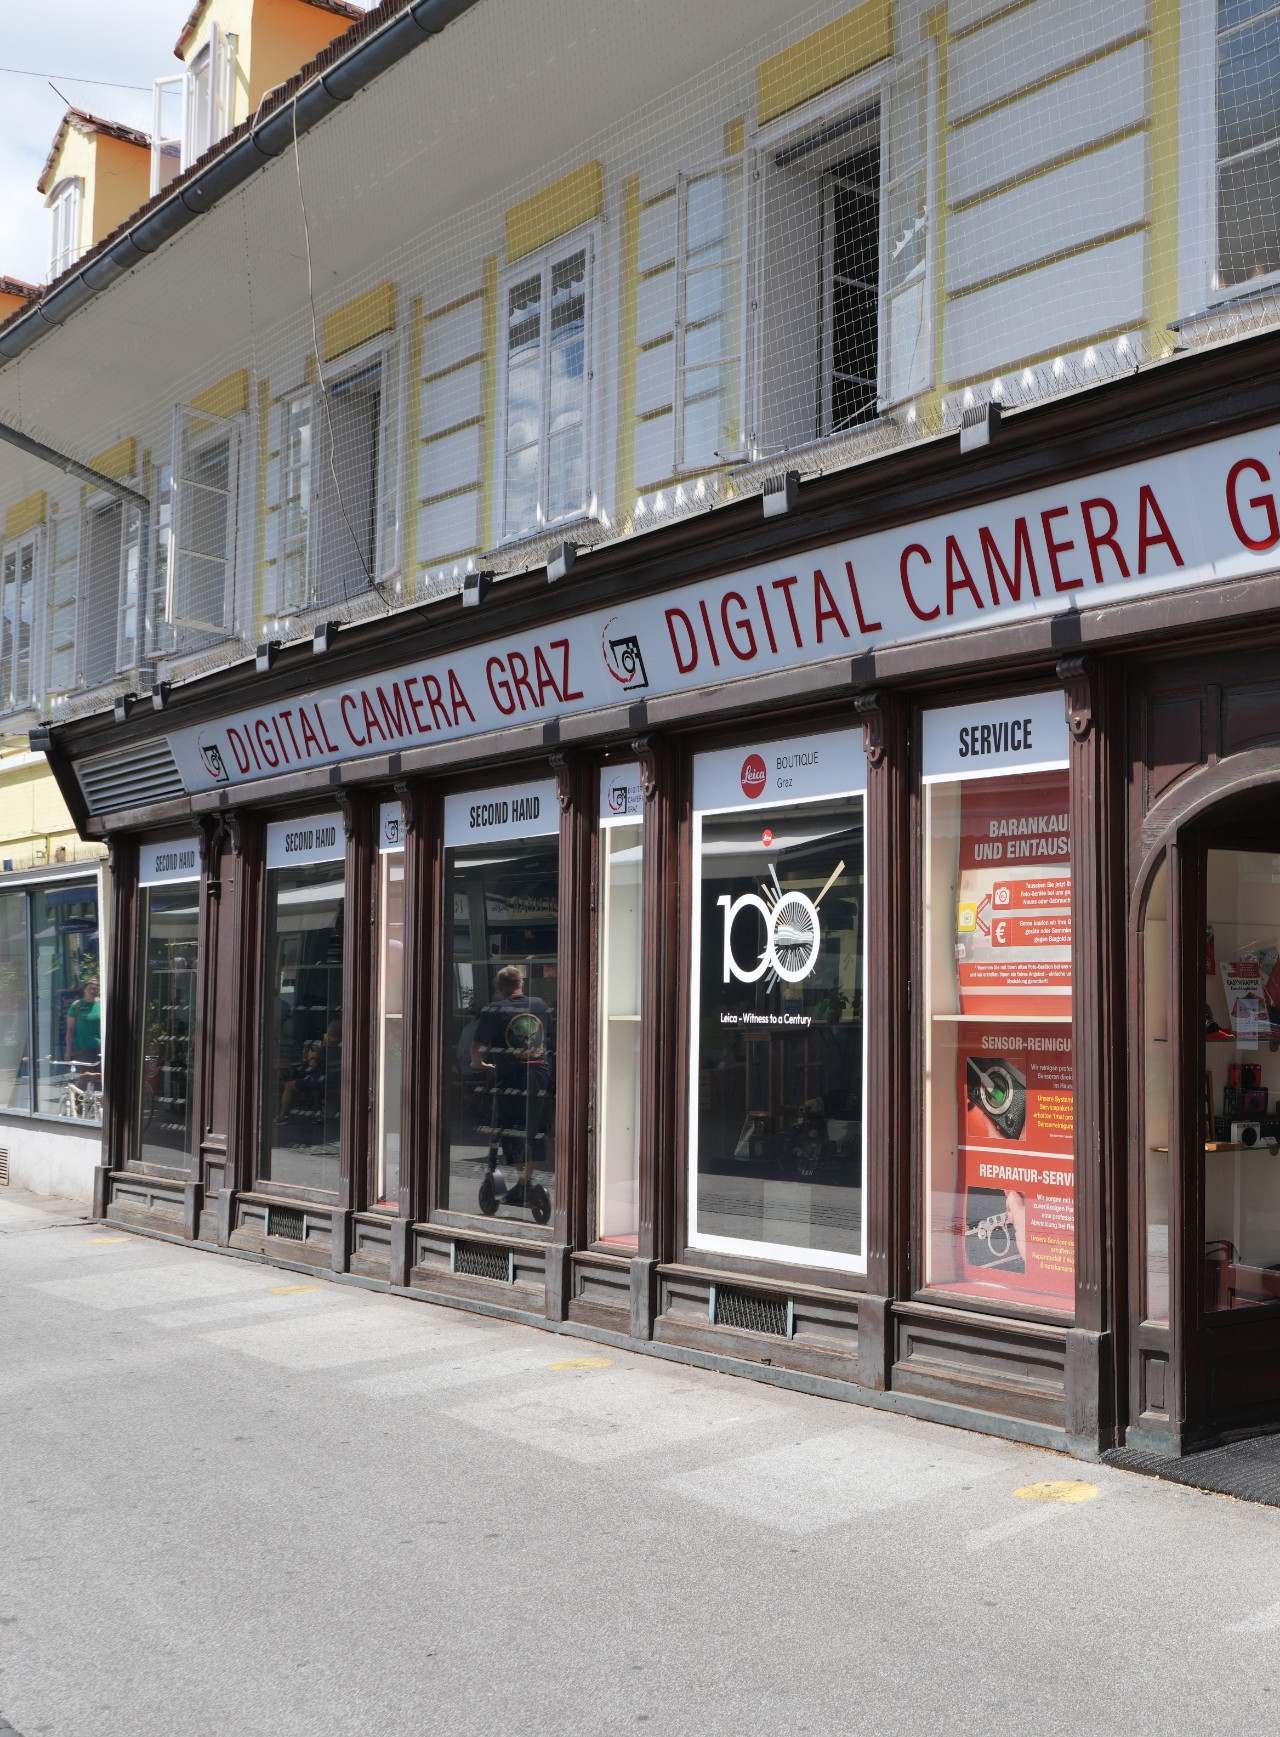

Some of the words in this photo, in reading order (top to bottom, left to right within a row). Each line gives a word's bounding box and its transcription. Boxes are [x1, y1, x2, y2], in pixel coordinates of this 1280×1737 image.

[663, 560, 882, 675] DIGITAL
[899, 484, 1185, 621] CAMERA
[226, 703, 339, 774] DIGITAL
[340, 669, 476, 747] CAMERA
[486, 638, 584, 715] GRAZ
[958, 718, 1033, 758] SERVICE
[776, 752, 819, 770] BOUTIQUE
[742, 765, 766, 784] Leica
[776, 778, 793, 788] Graz
[469, 802, 509, 829] SECOND
[511, 796, 540, 823] HAND
[285, 830, 314, 853] SECOND
[315, 826, 336, 849] HAND
[974, 843, 1002, 861] UND
[155, 854, 178, 873] SECOND
[178, 850, 195, 869] HAND
[717, 891, 820, 983] 100
[720, 1012, 738, 1023] Leica
[742, 1012, 769, 1024] Witness
[770, 1013, 777, 1024] to
[778, 1015, 783, 1024] a
[784, 1013, 812, 1028] Century
